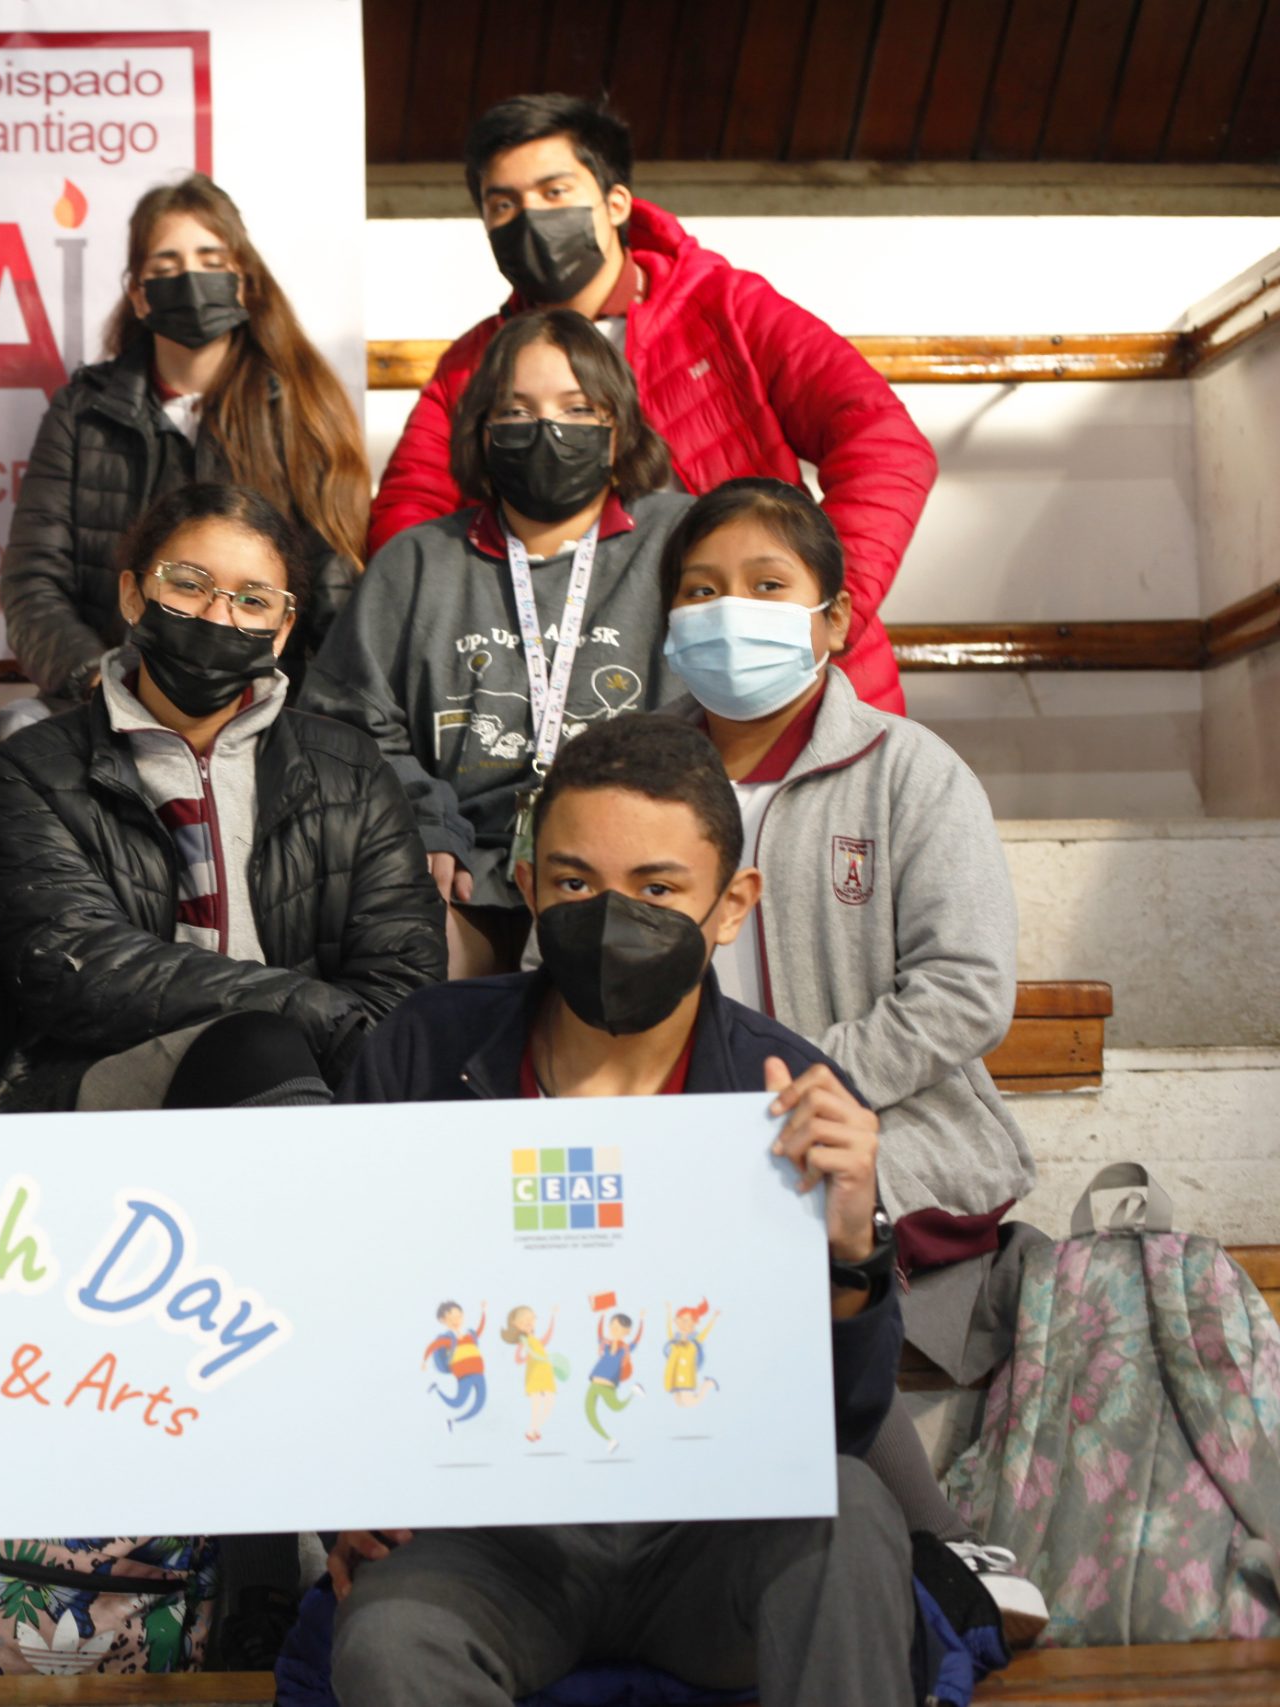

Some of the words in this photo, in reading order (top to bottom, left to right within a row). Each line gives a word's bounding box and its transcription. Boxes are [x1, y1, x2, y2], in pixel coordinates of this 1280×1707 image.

[516, 1176, 618, 1201] CEAS
[78, 1200, 280, 1379] Day
[0, 1343, 51, 1406] &
[65, 1353, 199, 1437] Arts
